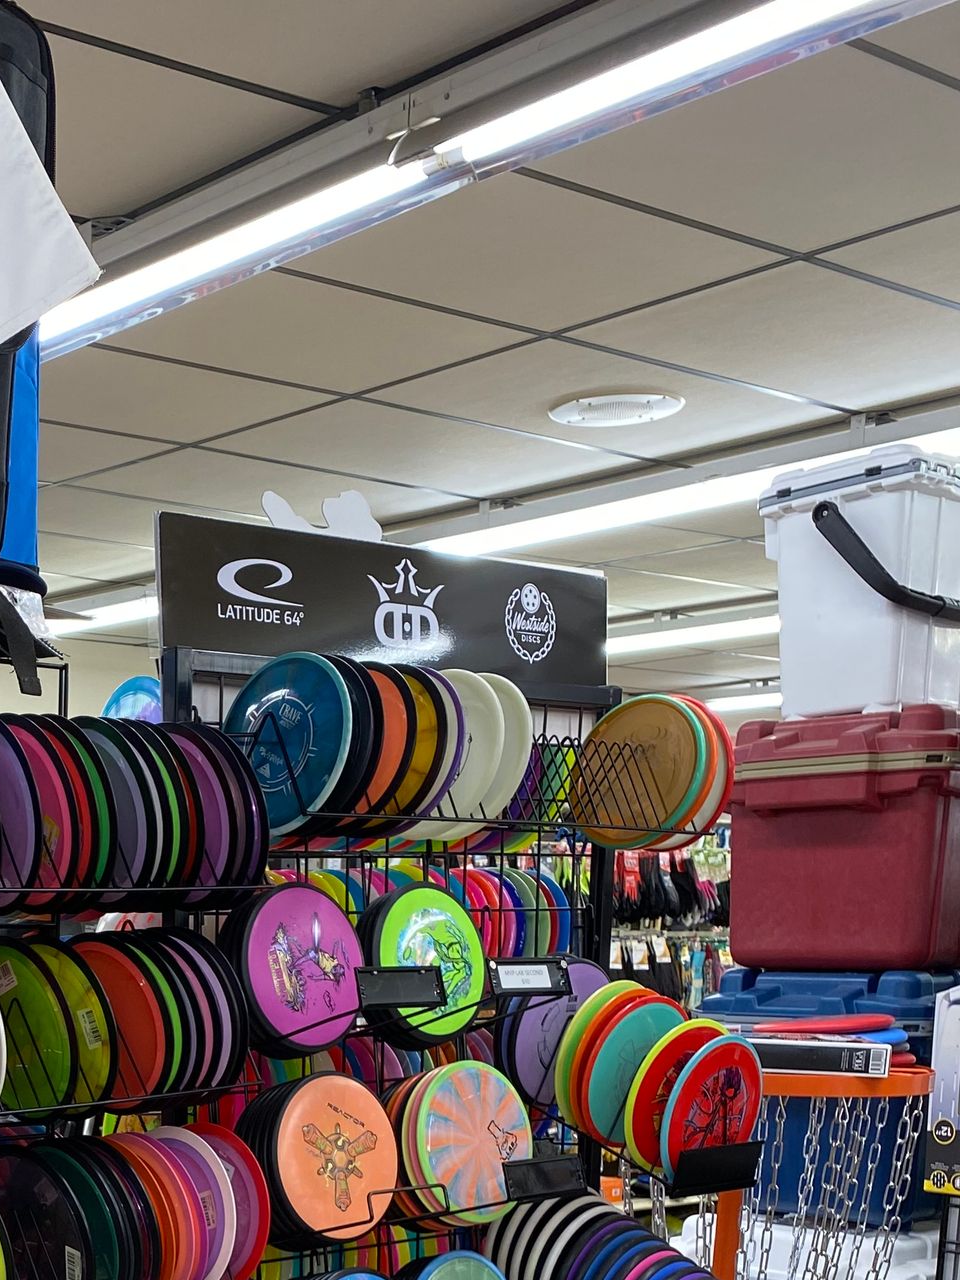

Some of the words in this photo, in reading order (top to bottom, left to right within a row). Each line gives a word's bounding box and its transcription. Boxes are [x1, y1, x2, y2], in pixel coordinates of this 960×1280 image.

[217, 602, 281, 624] LATITUDE
[512, 610, 550, 633] Westside
[521, 633, 541, 644] DISCS
[279, 702, 303, 725] CRAVE
[327, 1102, 366, 1129] REACTOR
